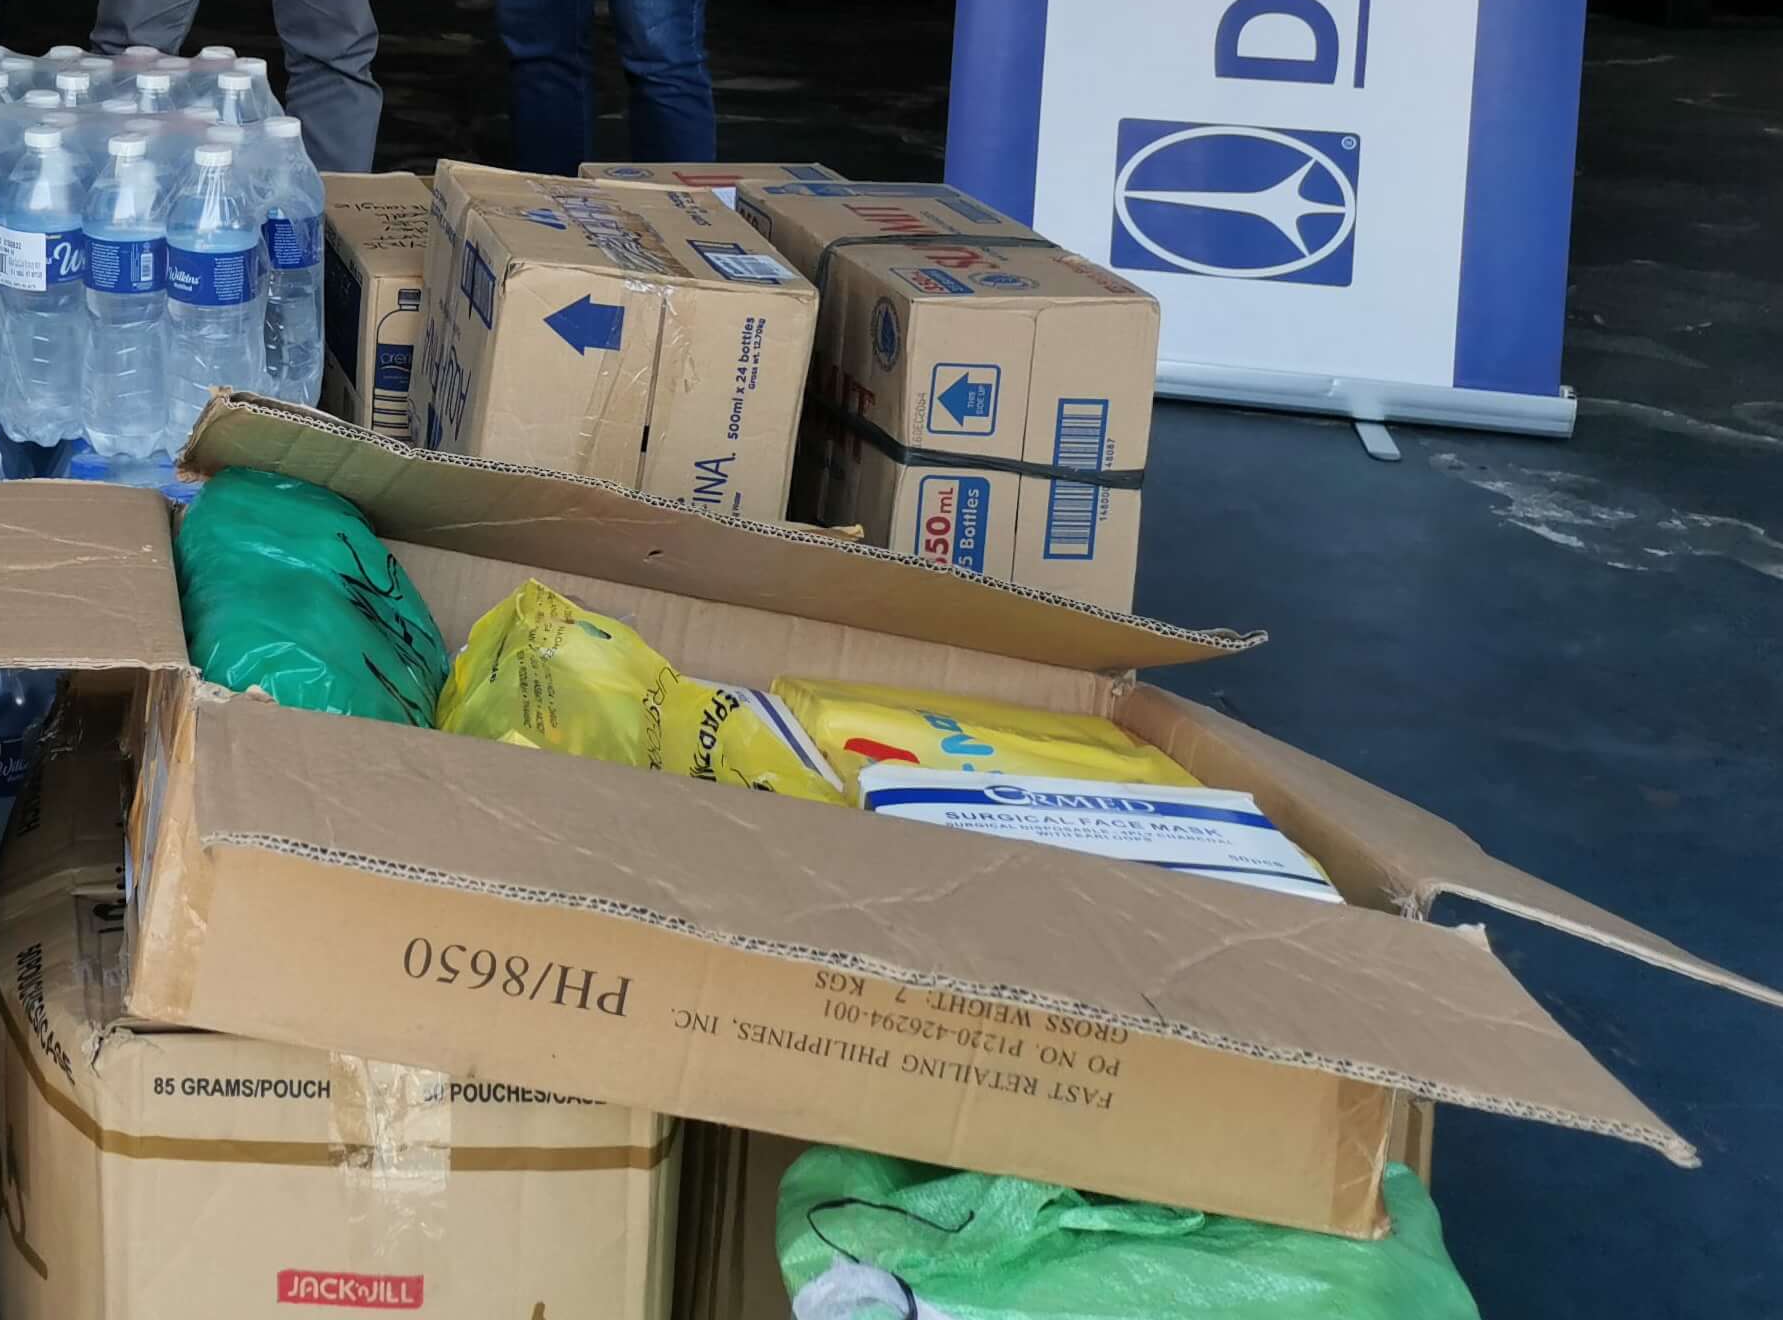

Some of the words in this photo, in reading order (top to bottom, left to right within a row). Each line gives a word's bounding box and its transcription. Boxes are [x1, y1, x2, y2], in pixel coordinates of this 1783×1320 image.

[738, 316, 756, 363] bottles
[735, 367, 748, 383] 24
[748, 366, 759, 390] Gross
[735, 386, 745, 395] x
[967, 391, 977, 409] THIS
[975, 395, 985, 415] SIDE
[727, 397, 745, 441] 500ml
[692, 452, 737, 508] INA.
[959, 488, 981, 548] Bottles
[944, 809, 1079, 828] SURGICAL
[1080, 817, 1145, 831] FACE
[1150, 821, 1223, 838] MASK
[1227, 852, 1286, 869] 50pcs
[400, 935, 633, 1019] PH/8650
[813, 968, 867, 998] KGS
[893, 985, 908, 1006] 7
[924, 988, 1031, 1029] WEIGHT:
[667, 1006, 720, 1035] INC.
[822, 997, 1023, 1059] P1220-426294-001
[1045, 1010, 1130, 1046] GROSS
[730, 1018, 890, 1069] PHILIPPINES,
[1033, 1042, 1077, 1070] NO.
[901, 1052, 1040, 1095] RETAILING
[1086, 1054, 1121, 1079] PO
[153, 1077, 176, 1096] 85
[180, 1078, 331, 1100] GRAMS/POUCH
[449, 1083, 608, 1105] POUCHES/
[1046, 1079, 1115, 1110] FAST
